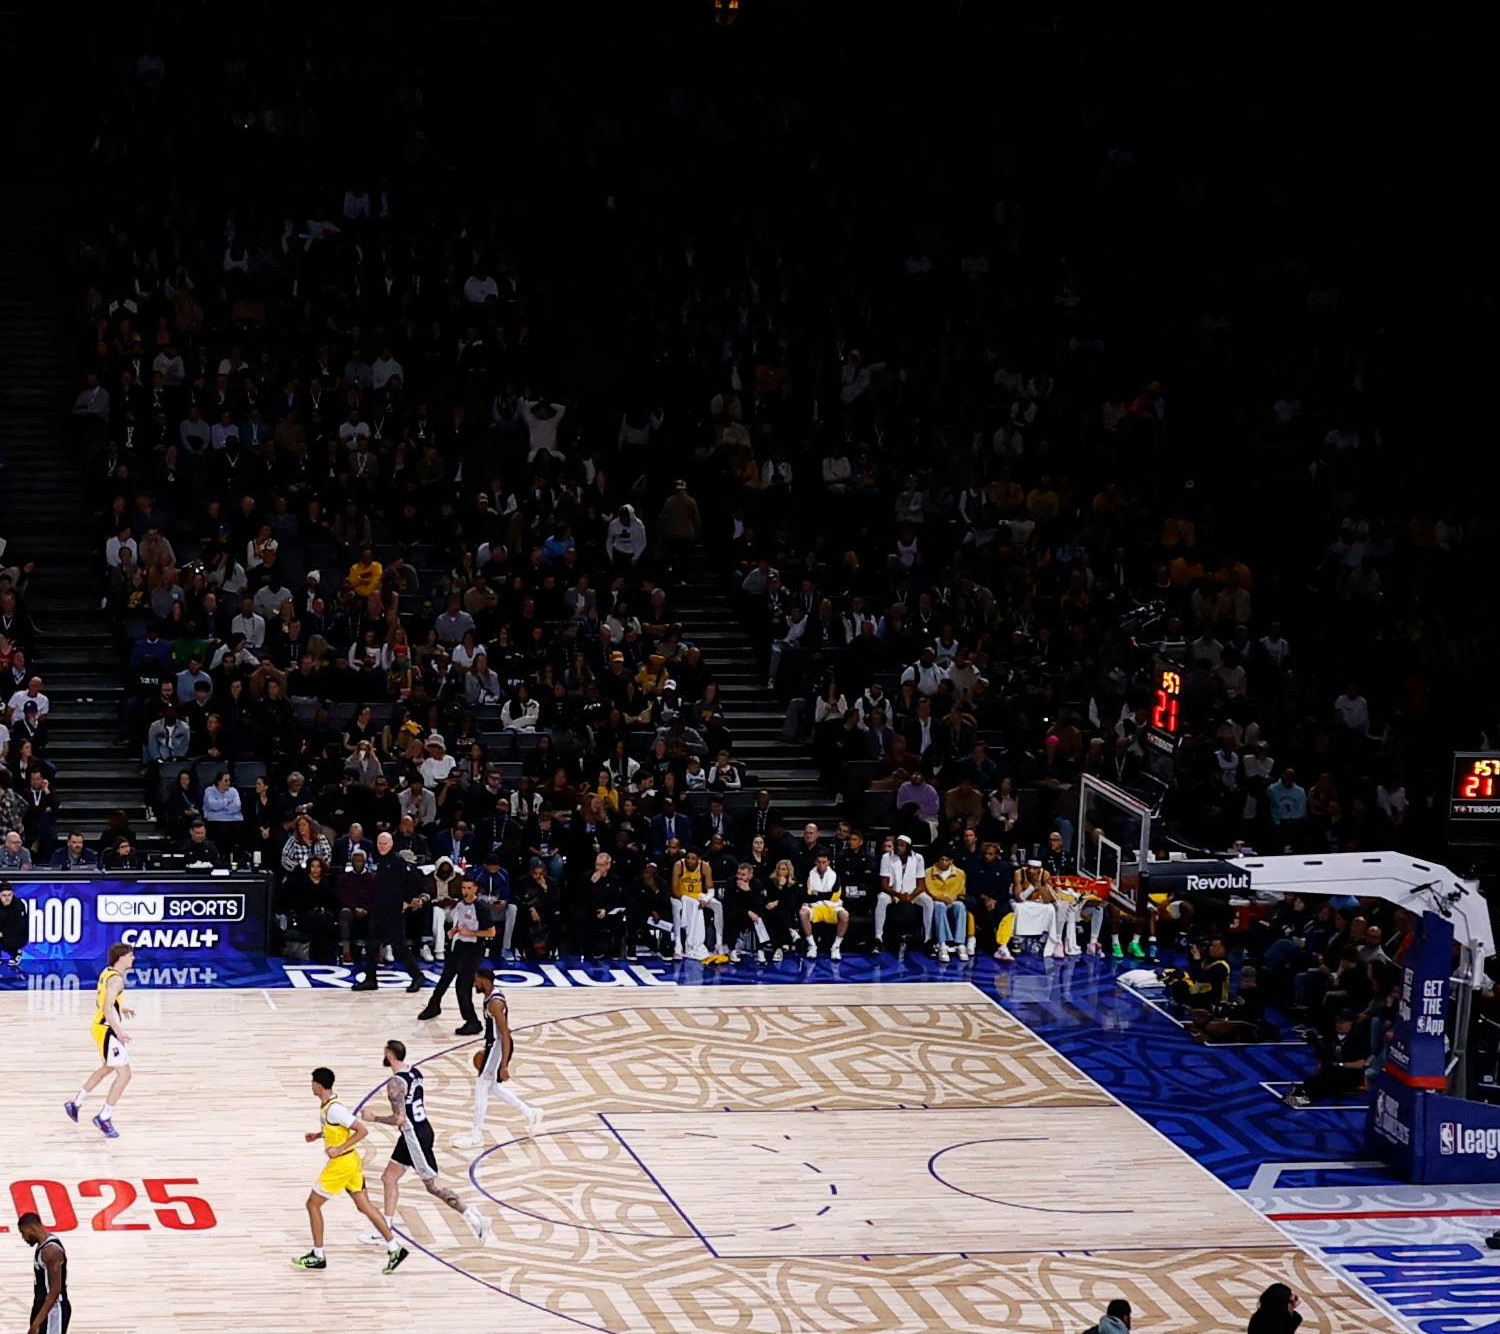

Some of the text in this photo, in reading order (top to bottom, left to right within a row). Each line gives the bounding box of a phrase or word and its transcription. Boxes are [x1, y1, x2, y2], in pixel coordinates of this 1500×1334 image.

[1153, 690, 1178, 732] 21
[1464, 776, 1493, 797] 21
[1186, 872, 1249, 893] Revolut
[104, 897, 238, 916] beIN SPORTS
[121, 928, 219, 948] CANAL+
[1423, 980, 1444, 997] GET
[1422, 998, 1442, 1015] THE
[1425, 1017, 1444, 1036] App
